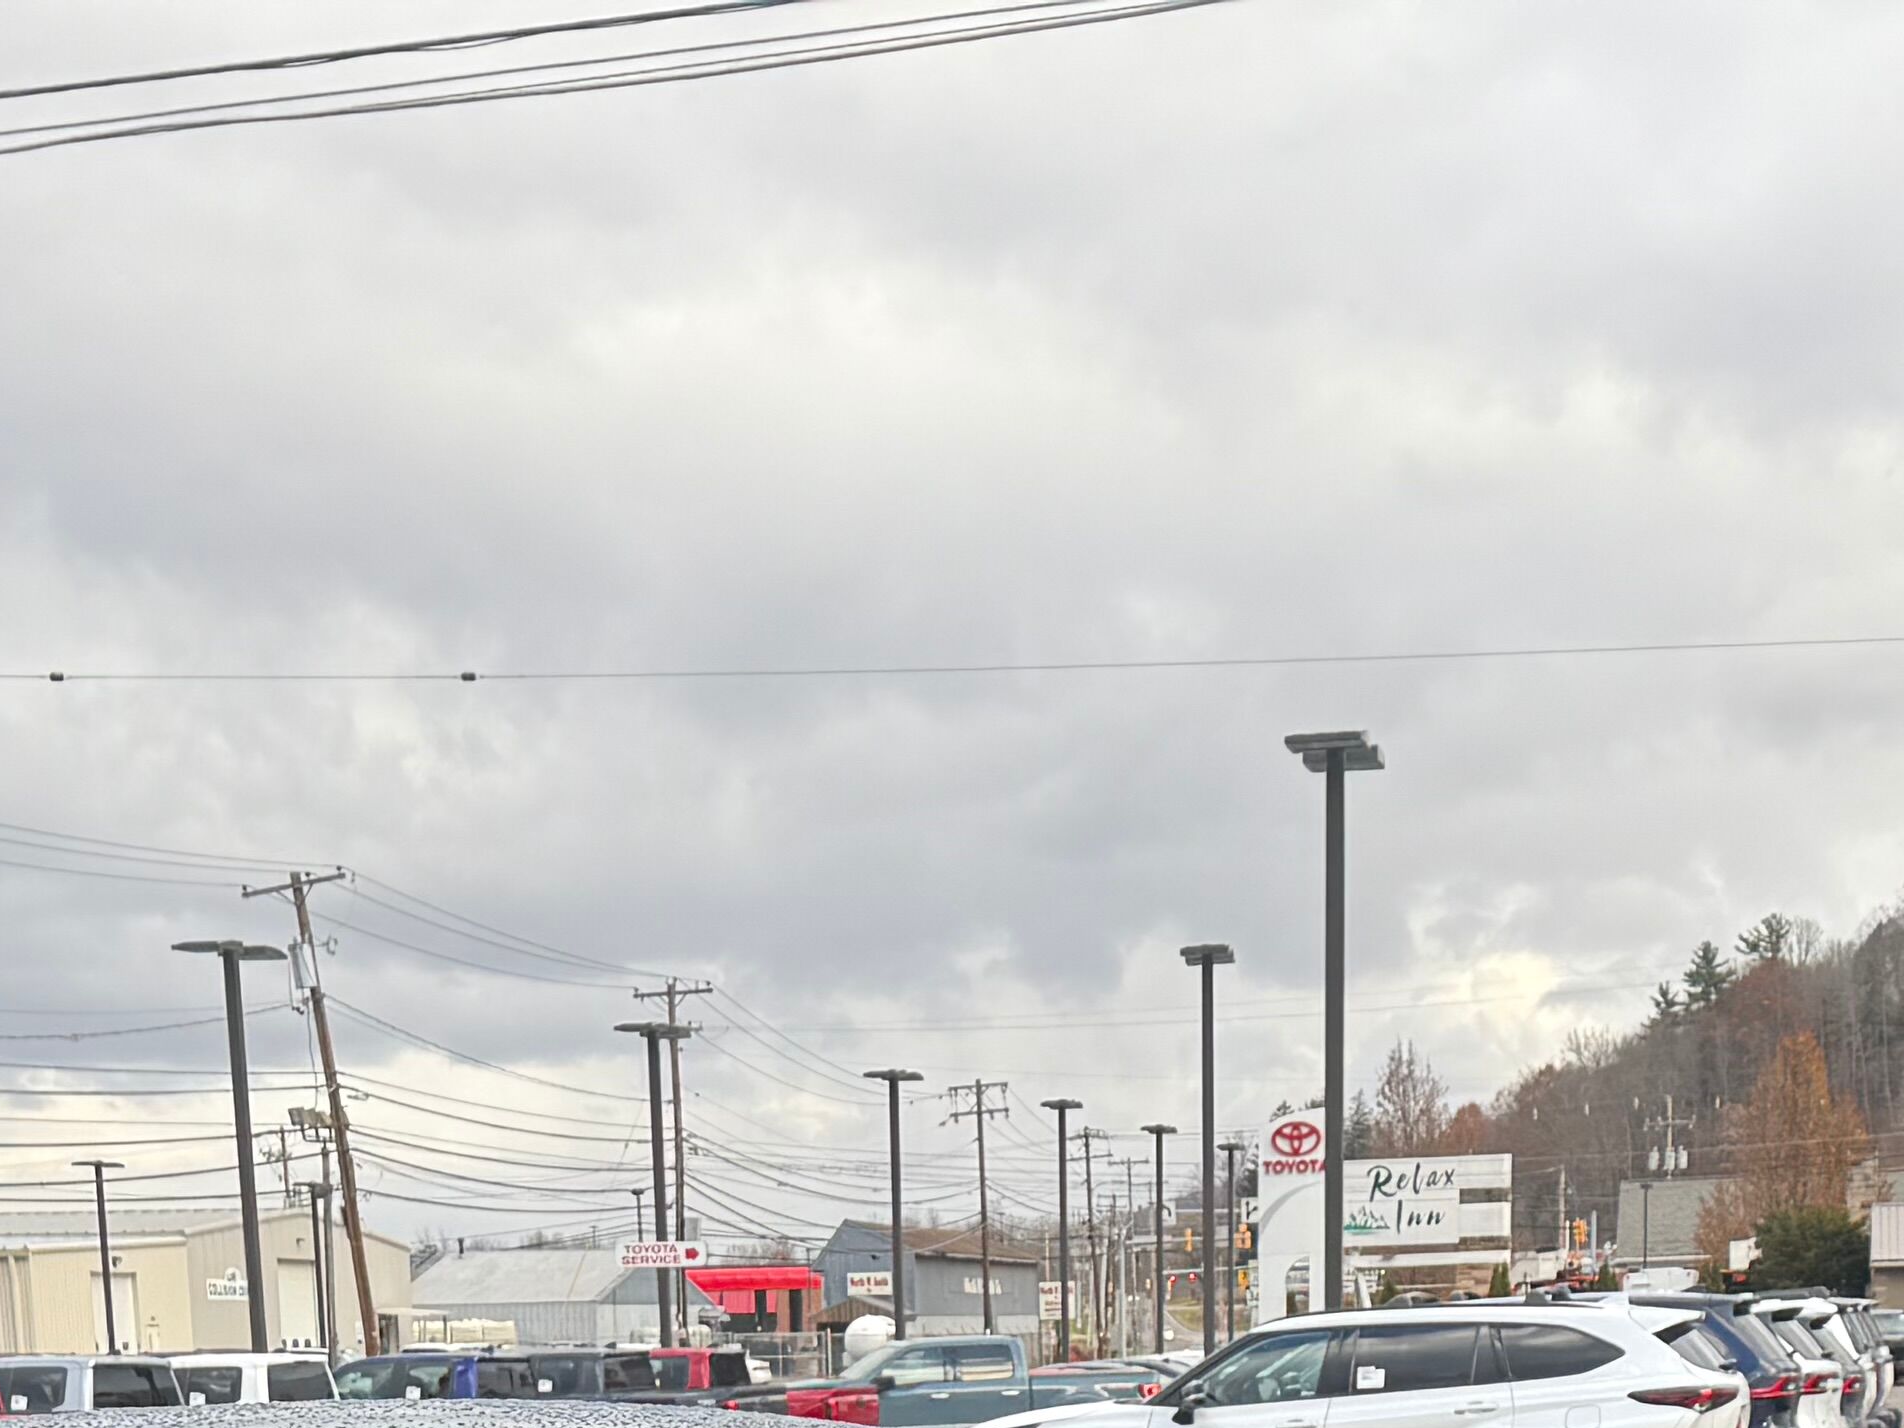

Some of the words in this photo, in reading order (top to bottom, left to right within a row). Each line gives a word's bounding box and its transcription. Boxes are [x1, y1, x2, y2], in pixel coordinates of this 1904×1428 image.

[1367, 1162, 1456, 1202] Relax
[1397, 1199, 1445, 1235] Inn
[621, 1254, 681, 1265] SERVICE
[624, 1244, 678, 1254] TOYOTA
